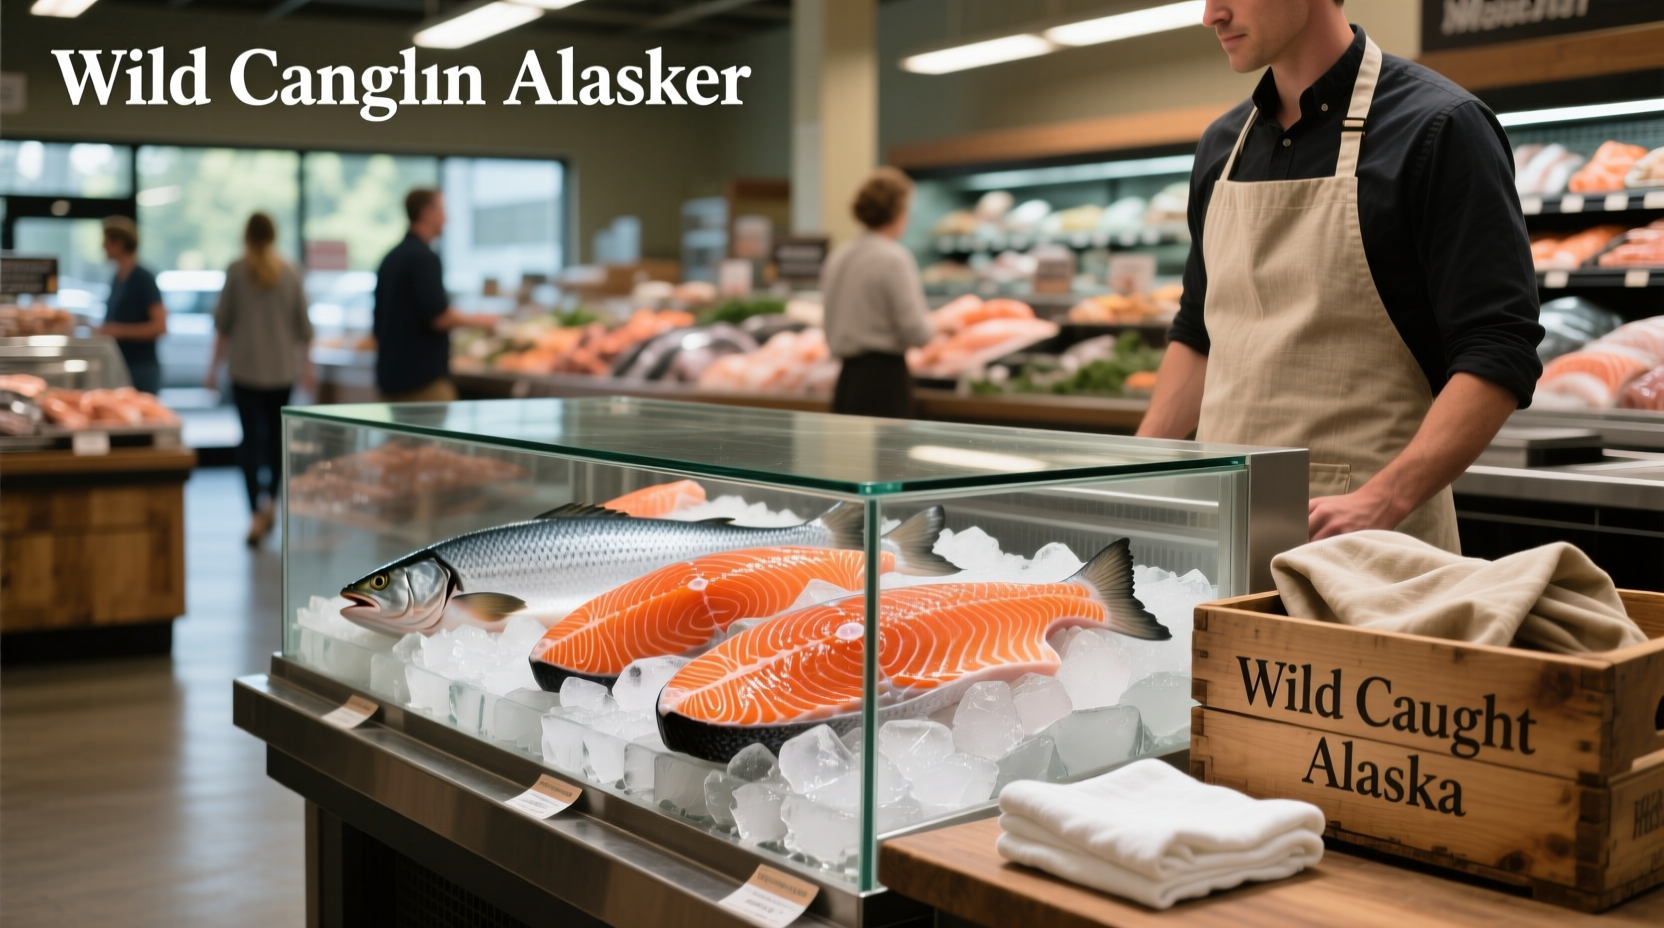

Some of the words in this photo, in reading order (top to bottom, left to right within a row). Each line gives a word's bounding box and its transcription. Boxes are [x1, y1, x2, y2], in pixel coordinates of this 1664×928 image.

[1236, 656, 1343, 719] Wild
[1356, 676, 1537, 759] Caught
[1302, 736, 1467, 817] Alaska
